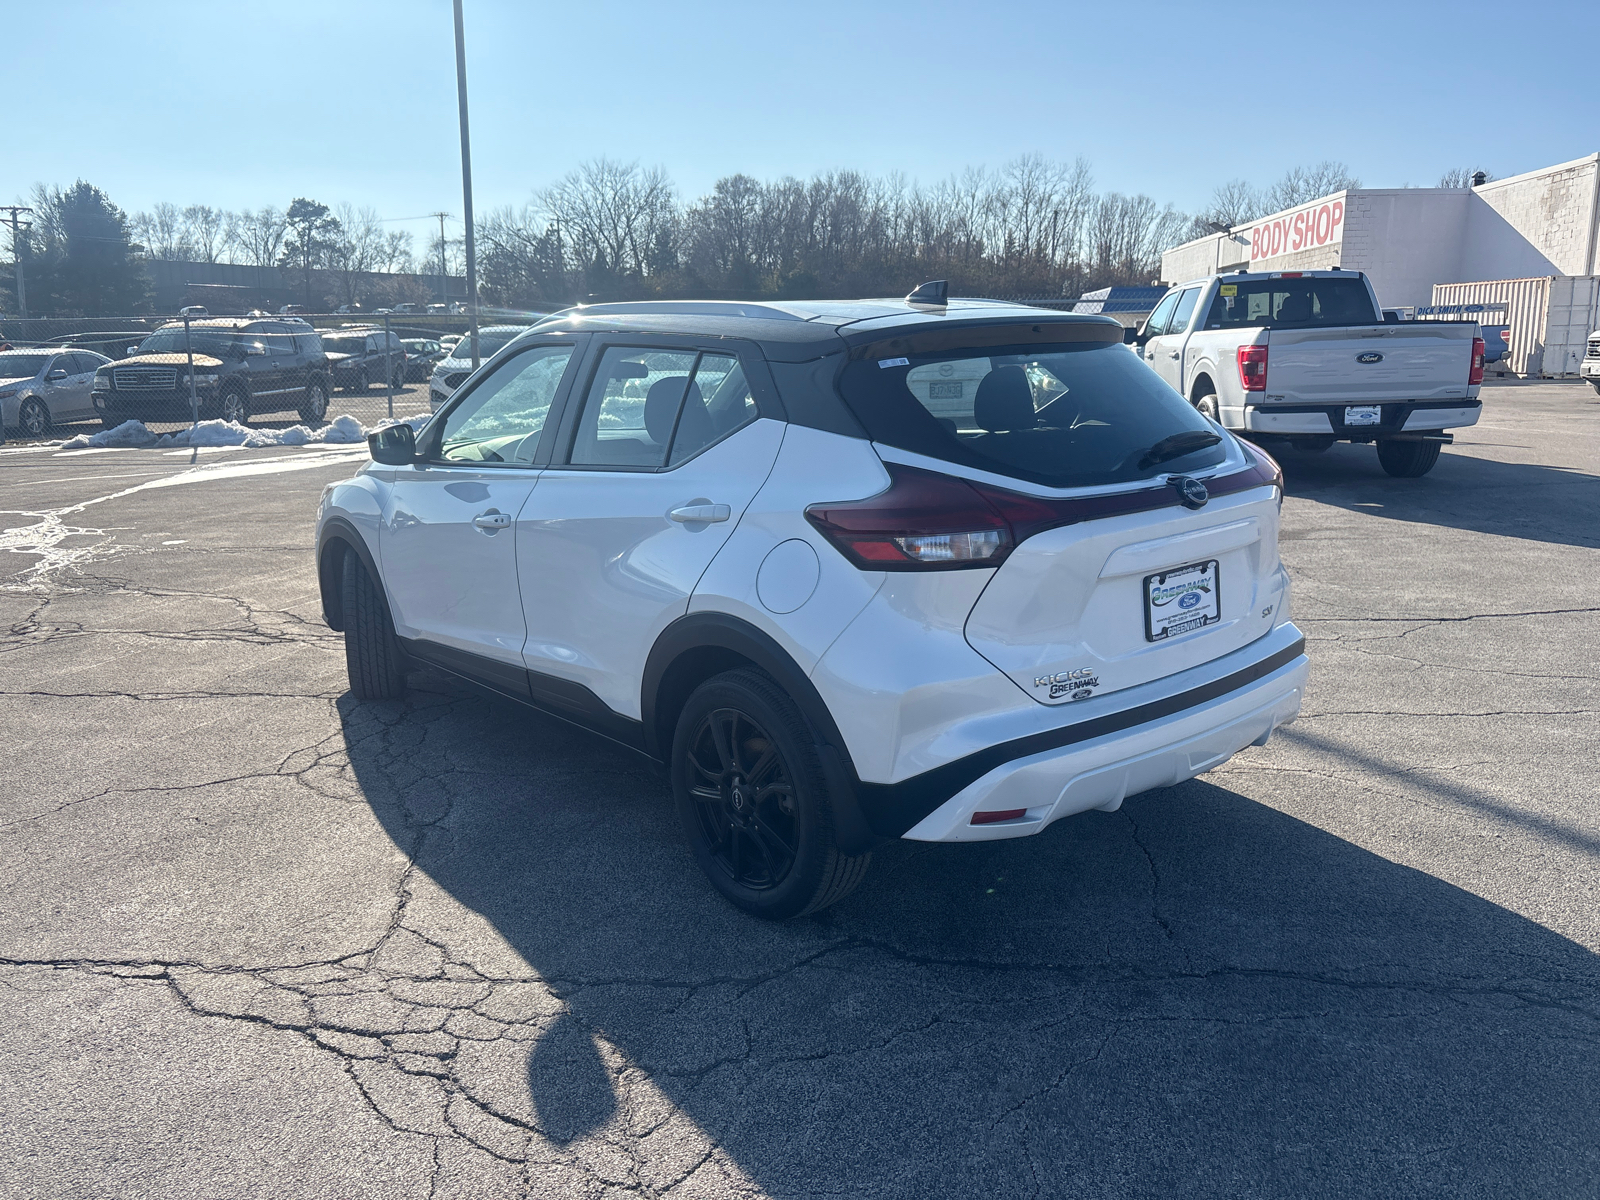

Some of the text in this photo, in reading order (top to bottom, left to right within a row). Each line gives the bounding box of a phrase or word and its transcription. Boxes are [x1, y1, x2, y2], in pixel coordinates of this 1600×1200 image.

[1417, 306, 1436, 315] DICK
[1437, 305, 1463, 314] SMITH
[1361, 354, 1379, 362] Ford
[1151, 577, 1212, 601] GREENWAY
[1167, 617, 1205, 637] GREENWAY
[1034, 666, 1093, 688] KICKS
[1050, 676, 1099, 695] GREENWAY
